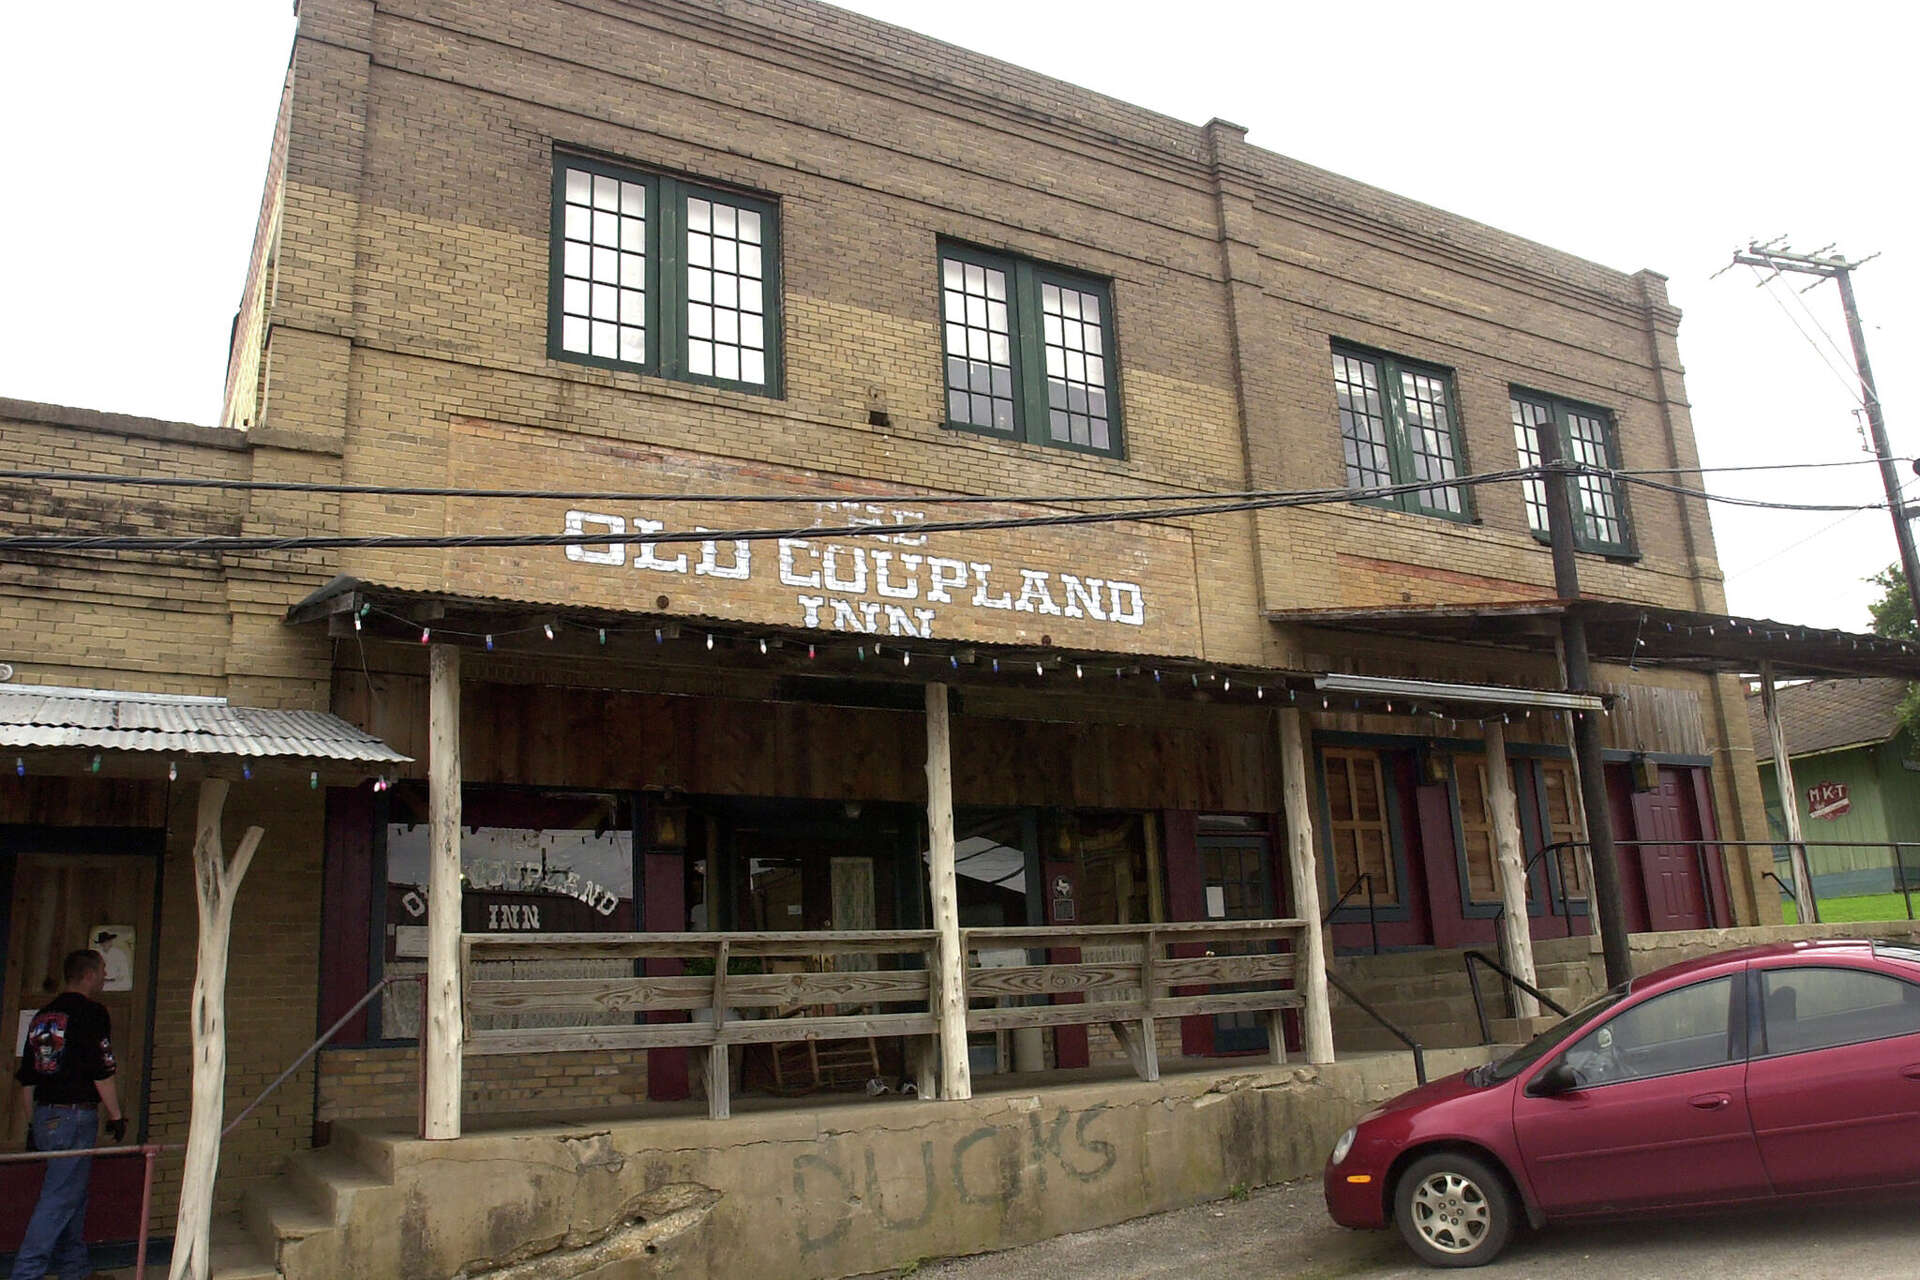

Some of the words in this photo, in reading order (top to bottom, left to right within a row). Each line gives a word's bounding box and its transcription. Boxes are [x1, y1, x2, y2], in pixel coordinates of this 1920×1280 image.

[563, 509, 751, 580] OLD
[777, 537, 1146, 626] COUPLAND
[797, 594, 936, 639] INN
[1808, 784, 1844, 802] MKT
[488, 904, 540, 930] INN
[793, 1101, 1117, 1253] DUCKS
